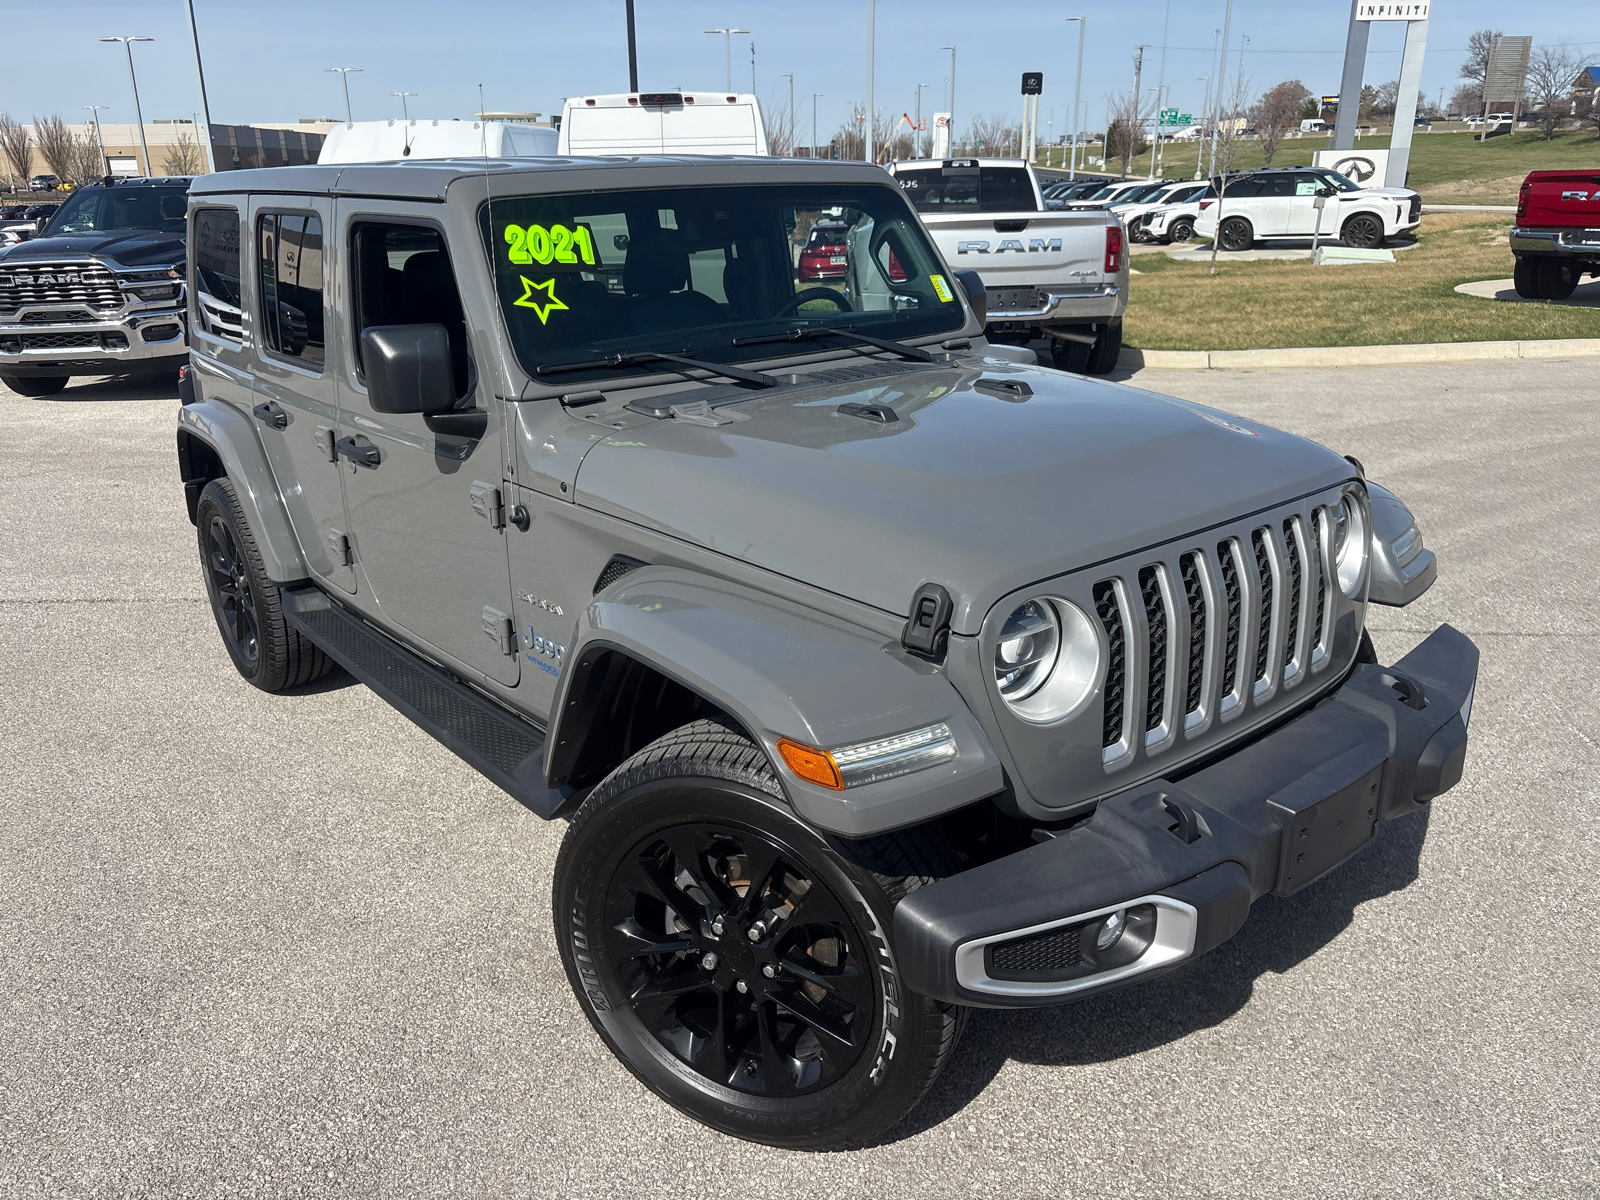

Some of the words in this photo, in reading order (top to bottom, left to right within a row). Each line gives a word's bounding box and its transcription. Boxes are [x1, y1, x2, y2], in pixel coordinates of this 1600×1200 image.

[1360, 5, 1427, 16] INFINITI
[504, 223, 596, 266] 2021
[957, 237, 1063, 255] RAM
[14, 272, 82, 285] RAM
[522, 624, 566, 667] Jeep
